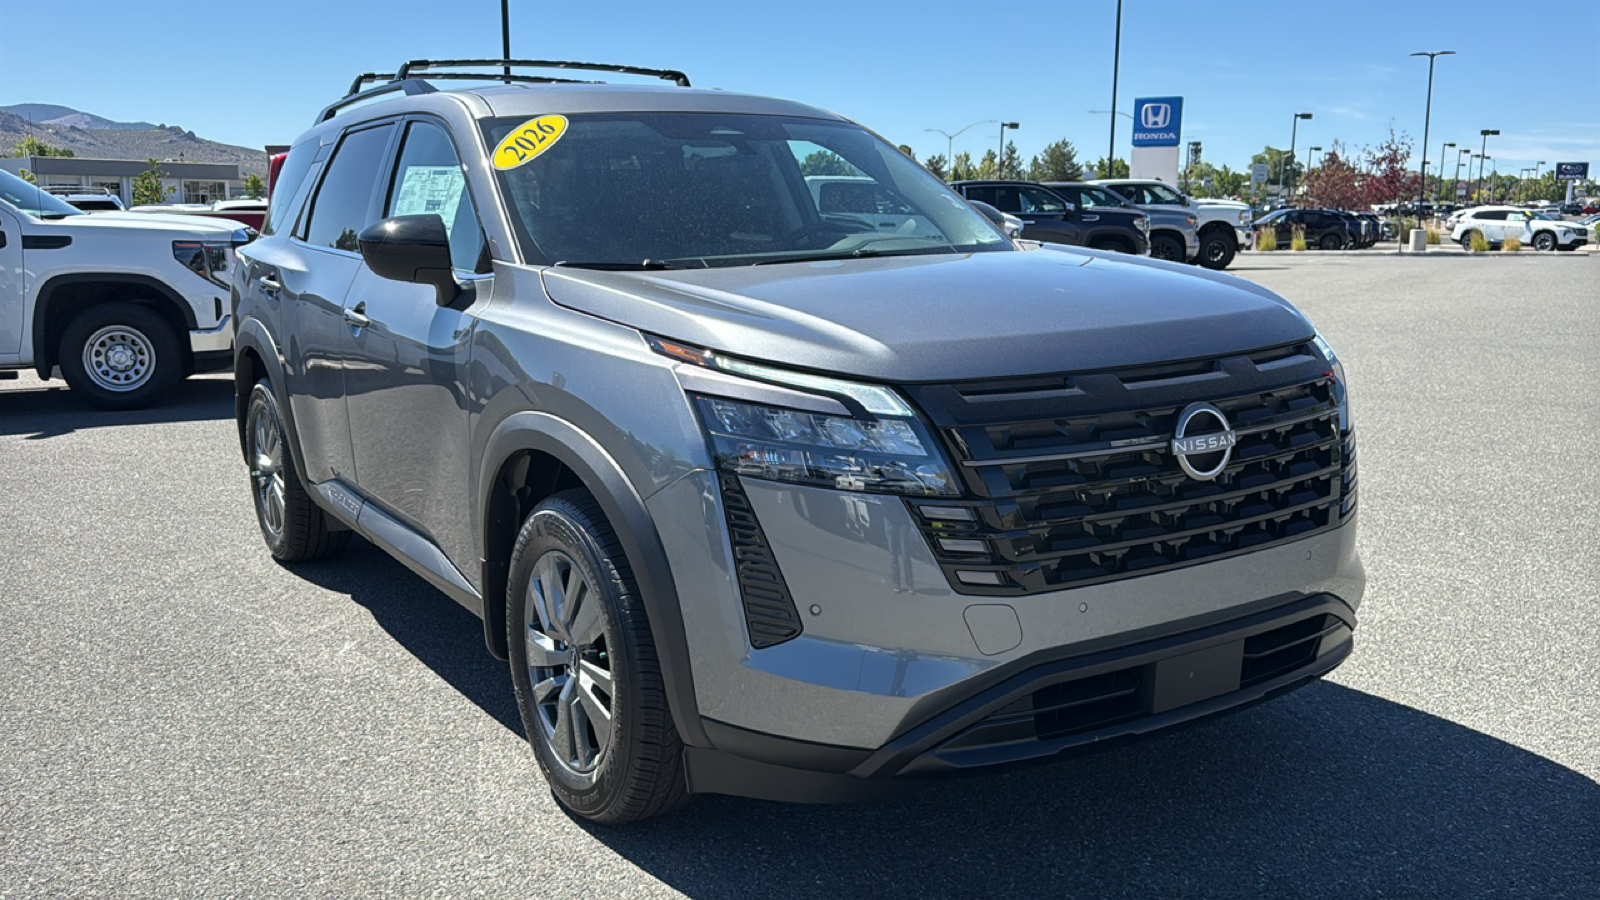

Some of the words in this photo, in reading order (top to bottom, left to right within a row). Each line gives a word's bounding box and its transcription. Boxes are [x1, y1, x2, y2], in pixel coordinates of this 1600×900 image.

[504, 120, 555, 161] 2026
[1134, 132, 1177, 140] HONDA
[1174, 433, 1236, 452] NISSAN
